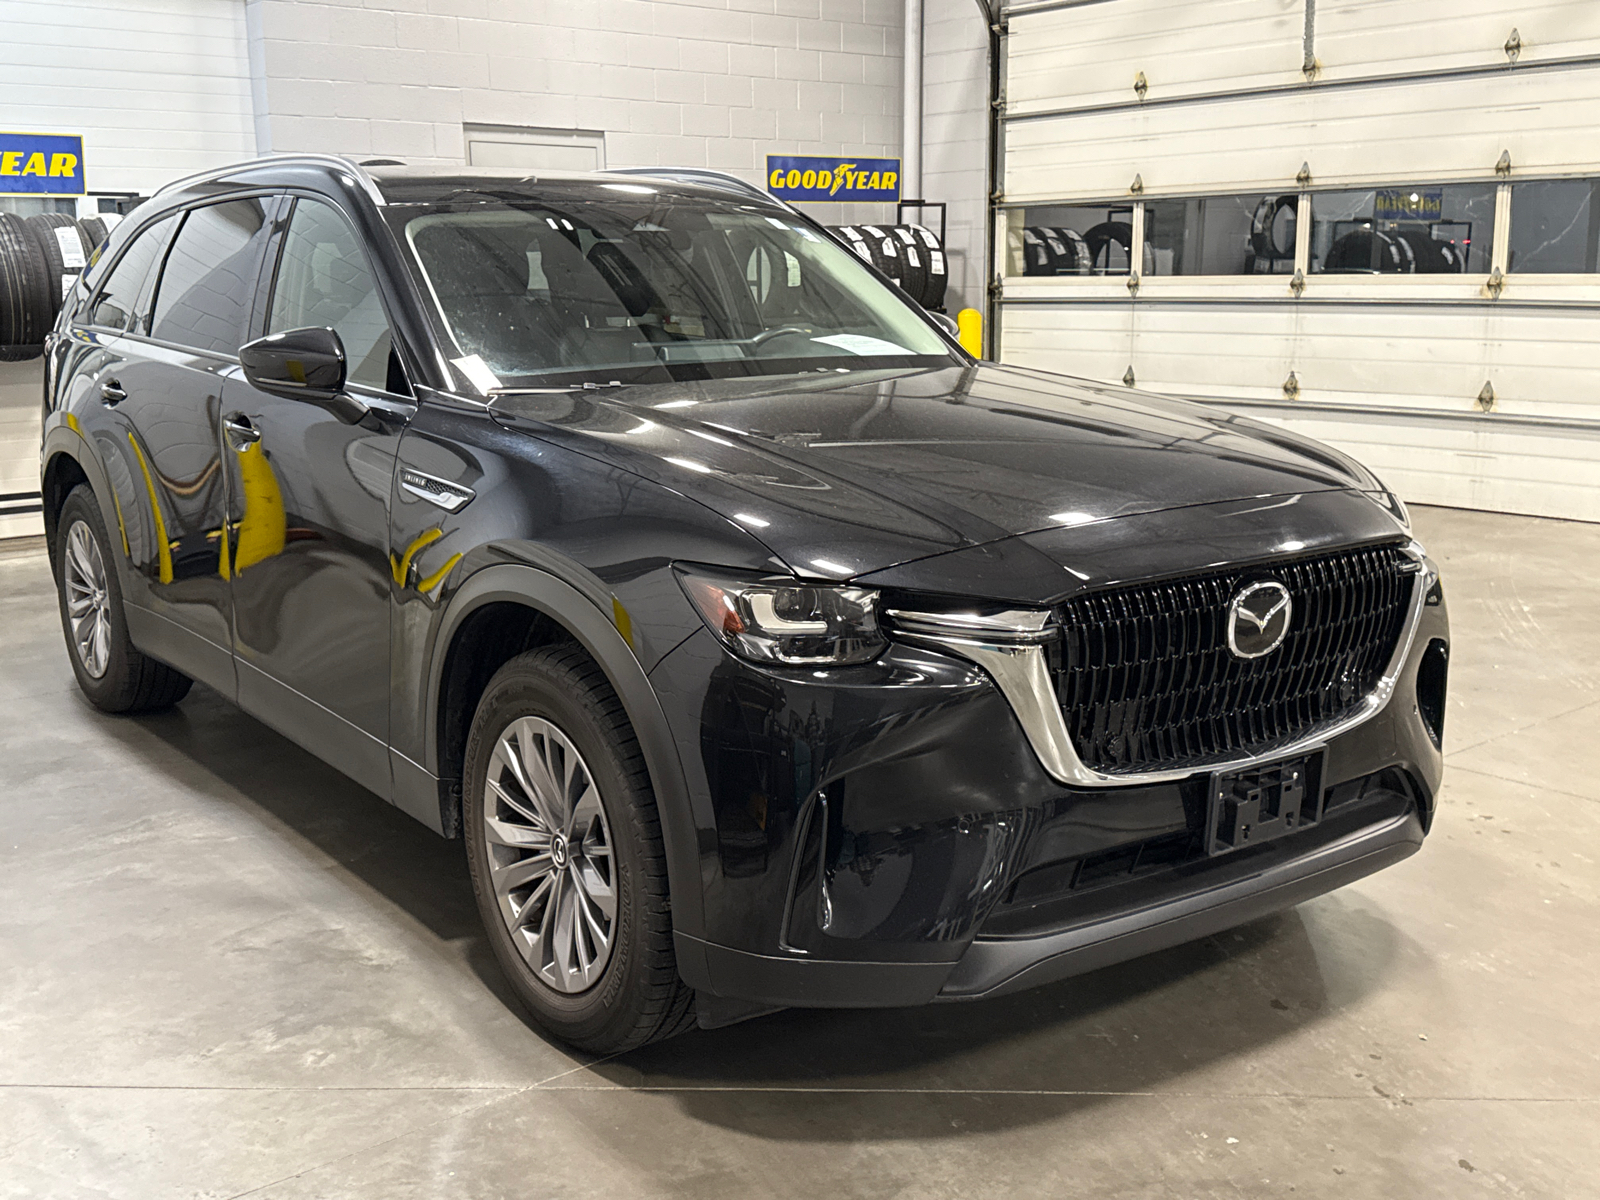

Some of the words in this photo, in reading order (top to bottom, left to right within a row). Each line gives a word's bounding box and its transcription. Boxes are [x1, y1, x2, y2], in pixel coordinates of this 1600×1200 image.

[0, 151, 77, 177] EAR
[769, 169, 897, 190] GOODYEAR
[602, 861, 632, 1008] YOKOHAMA
